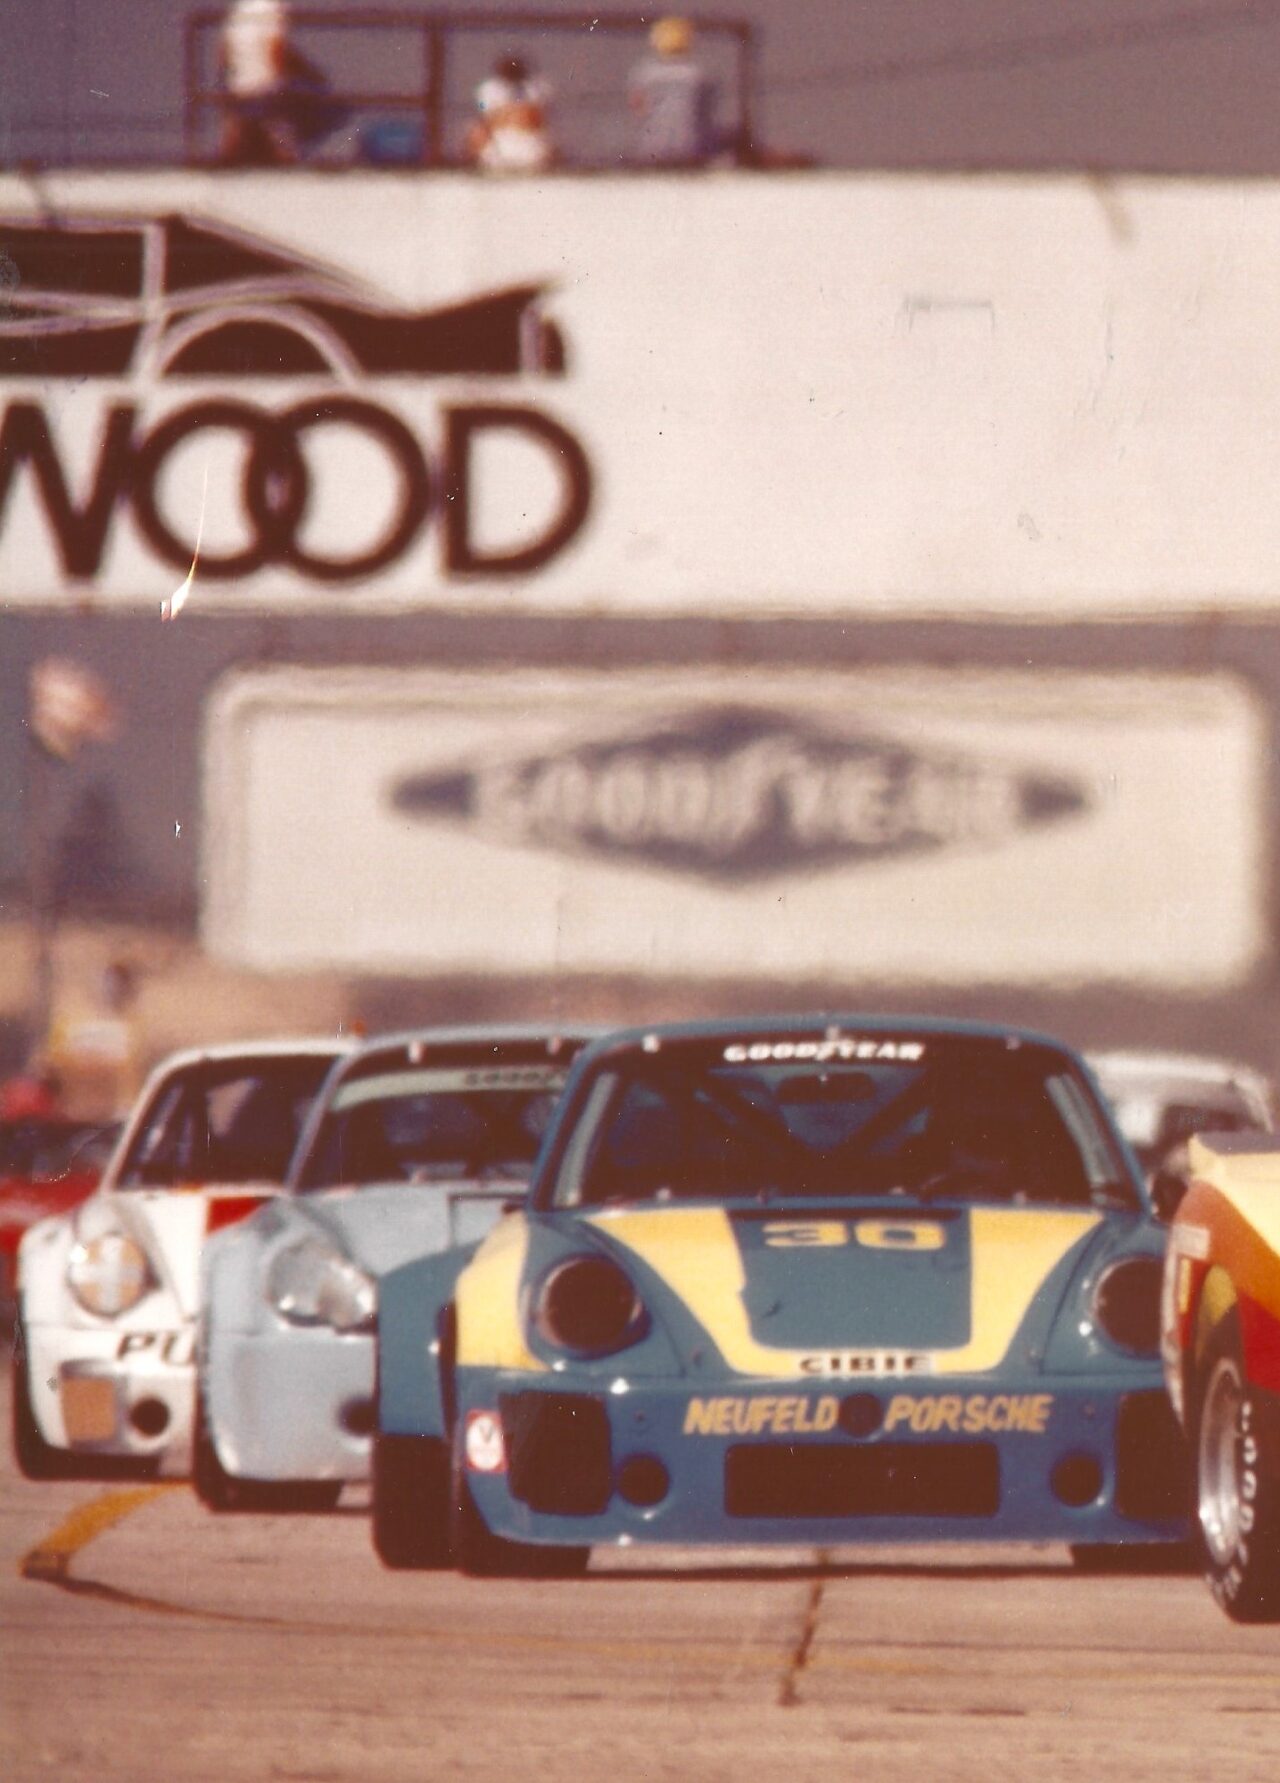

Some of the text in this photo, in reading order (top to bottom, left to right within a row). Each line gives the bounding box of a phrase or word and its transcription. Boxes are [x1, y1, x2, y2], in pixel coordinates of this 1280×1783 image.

[723, 1038, 925, 1063] GOODYEAR
[763, 1221, 945, 1251] 30
[683, 1394, 1053, 1435] NEUFELD PORSCHE
